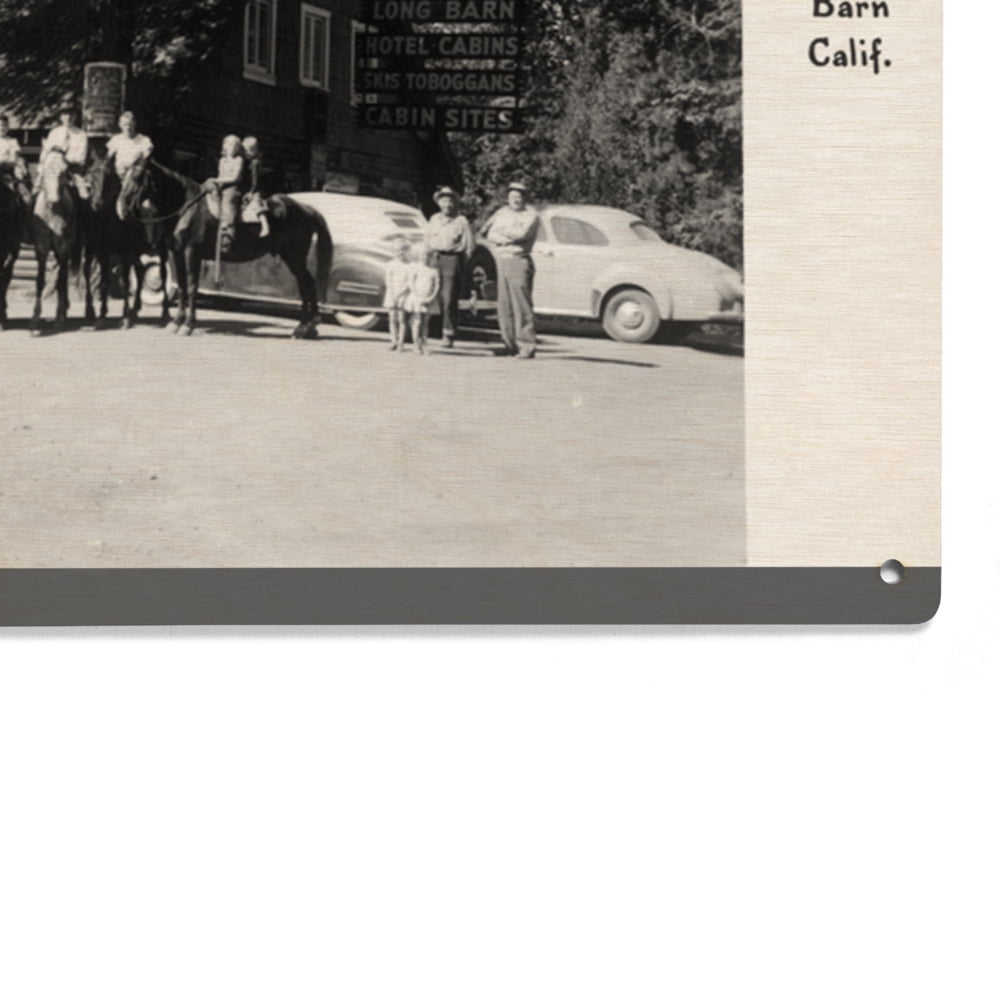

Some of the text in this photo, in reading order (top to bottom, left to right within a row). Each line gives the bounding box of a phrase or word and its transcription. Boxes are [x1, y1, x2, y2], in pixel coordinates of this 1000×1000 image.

[373, 0, 515, 20] LONG BARN
[365, 35, 519, 56] HOTEL CABINS
[807, 36, 892, 75] Calif.
[364, 72, 515, 92] SKIS TOBOGGANS
[365, 107, 514, 129] CABIN SITES
